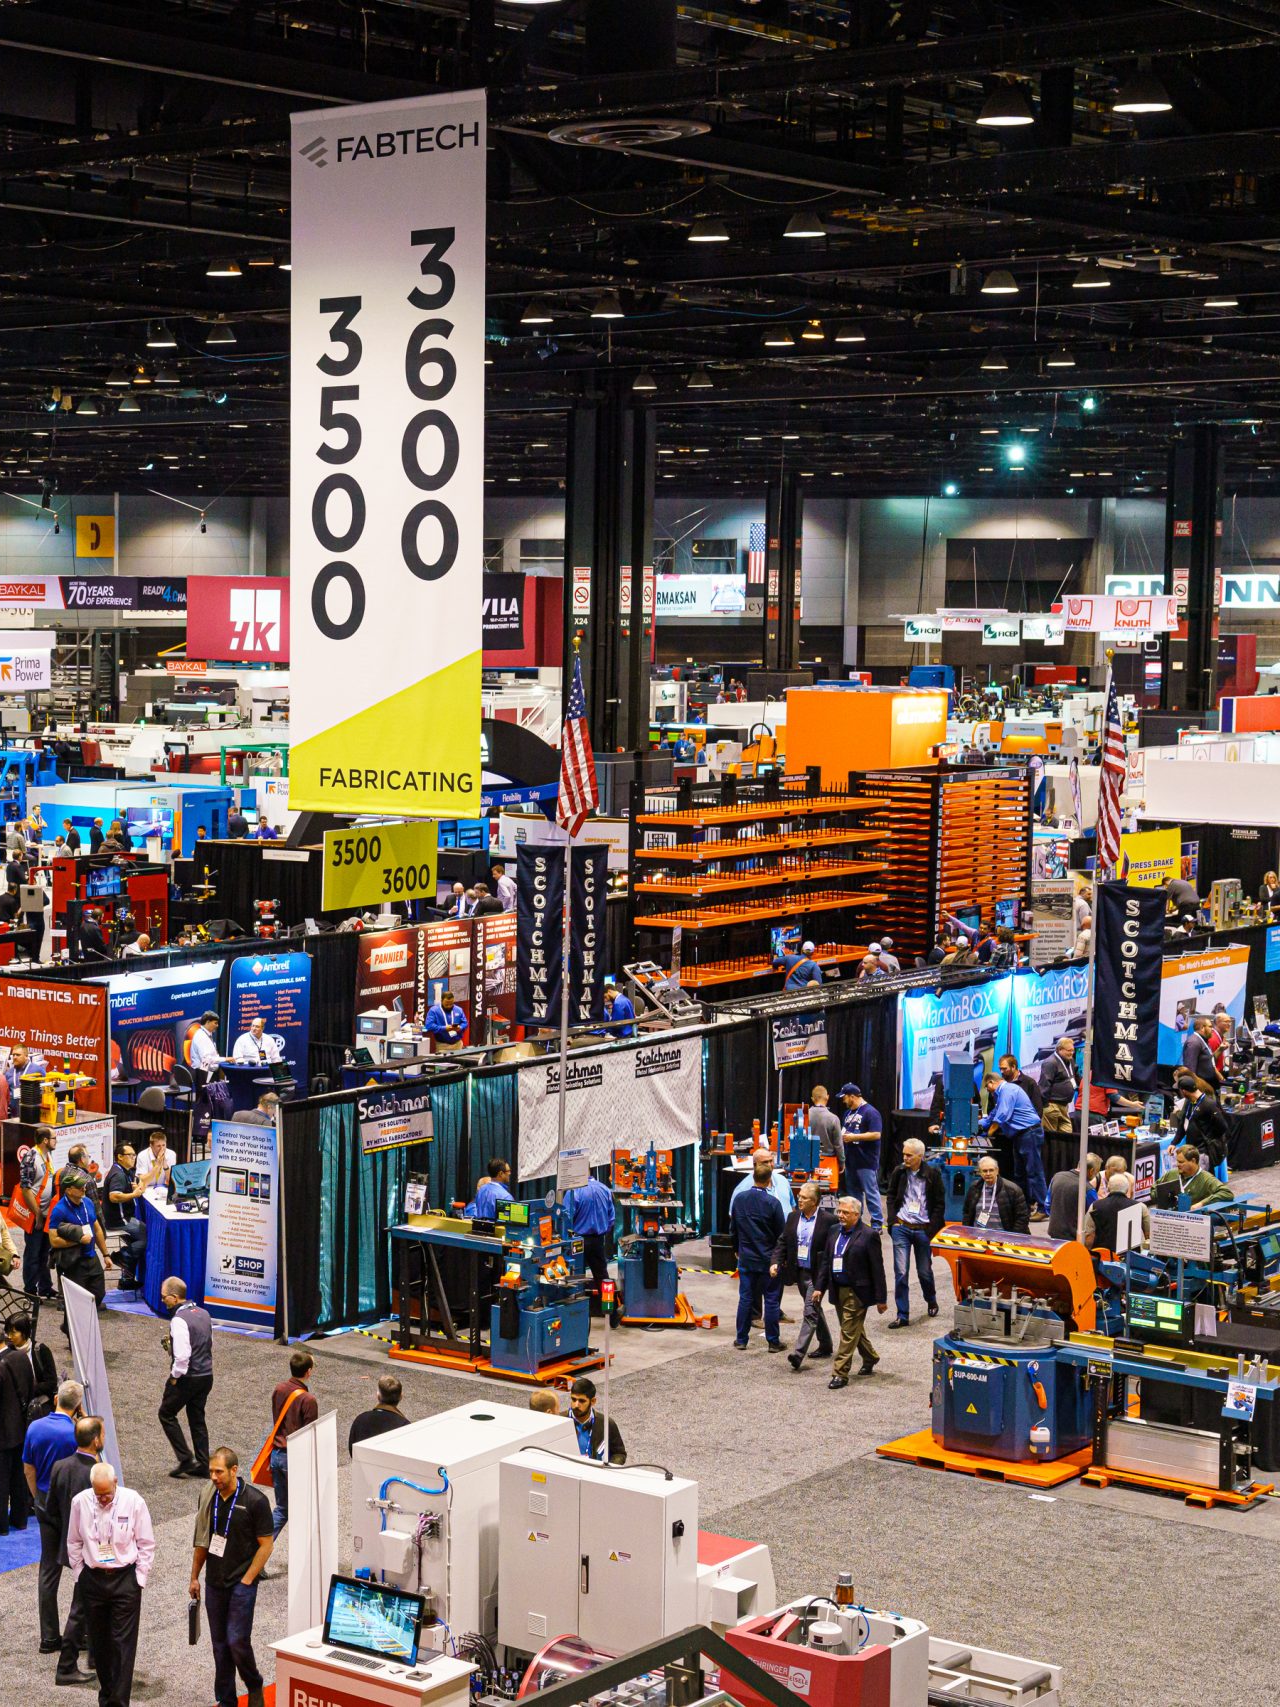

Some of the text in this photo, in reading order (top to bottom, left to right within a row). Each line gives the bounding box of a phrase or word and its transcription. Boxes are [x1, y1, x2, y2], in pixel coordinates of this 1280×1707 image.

[336, 121, 480, 163] FABTECH
[401, 226, 460, 582] 3600
[311, 295, 367, 641] 3500
[0, 585, 44, 595] BAYKAL
[67, 586, 114, 605] 70 YEARS
[143, 585, 166, 596] READY
[86, 597, 132, 606] OF EXPERIENCE
[574, 617, 588, 625] X24
[1066, 618, 1091, 627] KNUTH
[1114, 619, 1151, 627] KNUTH
[15, 656, 41, 669] Prima
[167, 661, 206, 672] BAYKAL
[15, 668, 44, 682] Power
[319, 767, 473, 793] FABRICATING
[332, 835, 382, 867] 3500
[1130, 858, 1174, 869] PRESS BRAKE
[382, 864, 431, 895] 3600
[1138, 871, 1166, 882] SAFETY
[530, 856, 548, 1019] SCOTCHMAN
[579, 858, 595, 1020] SCOTCHMAN
[263, 960, 290, 972] Ambrell
[374, 950, 404, 966] PANNIER
[417, 929, 425, 1027] PART MARKING
[1113, 899, 1141, 1082] SCOTCHMAN
[475, 986, 483, 1018] TAGS
[919, 990, 993, 1028] MarkinBOX
[118, 1010, 184, 1026] INDUCTION HEATING SOLUTIONS
[30, 1028, 63, 1046] Things
[65, 1033, 98, 1048] Better
[635, 1047, 682, 1068] Scotchman
[546, 1061, 603, 1083] Sctchman
[358, 1093, 430, 1120] Scotchman
[78, 1126, 94, 1135] MOVE
[95, 1122, 112, 1132] METAL
[218, 1131, 238, 1139] Control
[235, 1148, 268, 1158] ANYWHERE
[1136, 1160, 1154, 1181] MB
[1135, 1178, 1154, 1191] METAL
[238, 1258, 262, 1270] SHOP
[954, 1370, 988, 1383] SUP-600-AM
[790, 1675, 808, 1686] EISELE
